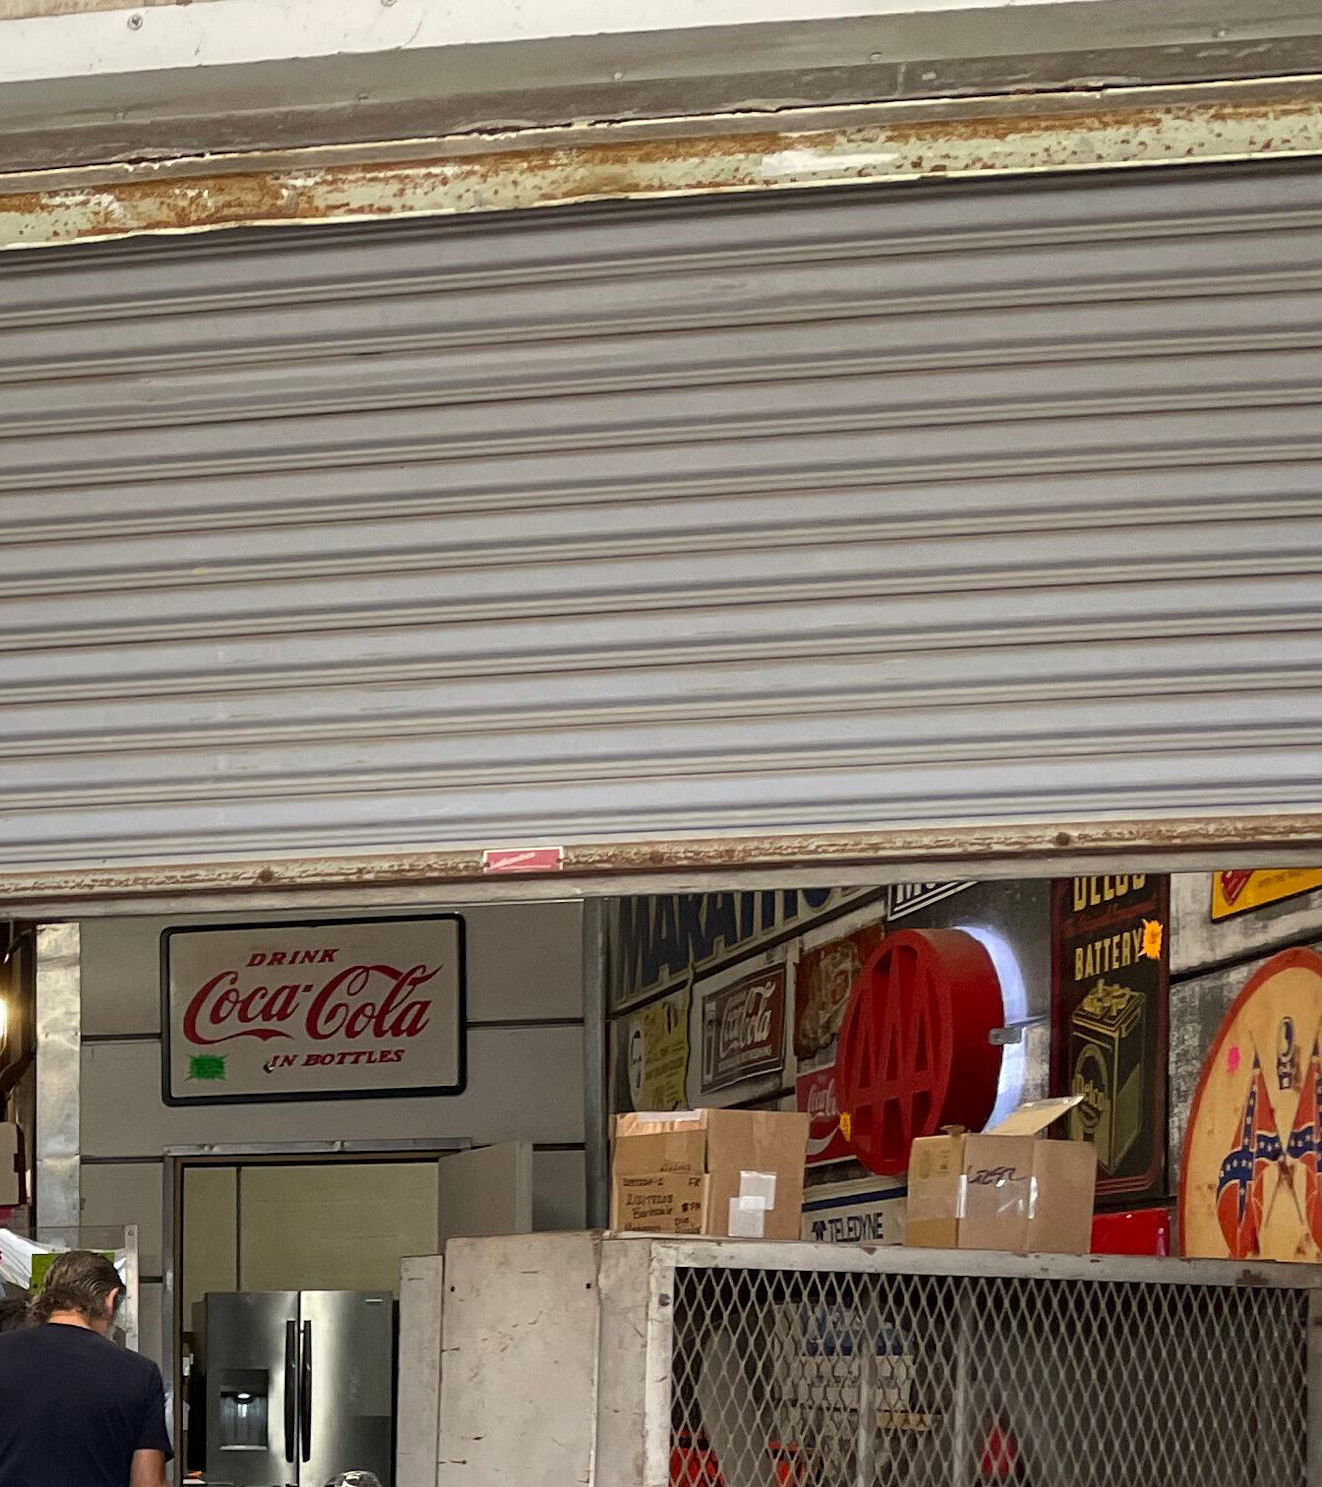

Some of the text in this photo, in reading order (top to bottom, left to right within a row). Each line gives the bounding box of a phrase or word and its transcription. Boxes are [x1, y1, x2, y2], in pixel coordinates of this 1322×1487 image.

[246, 947, 341, 968] DRINK
[1074, 927, 1143, 981] BATTERY
[182, 963, 445, 1046] Coca-Cola
[269, 1050, 405, 1067] IN BOTTLES
[828, 1212, 884, 1242] TELEDYNE
